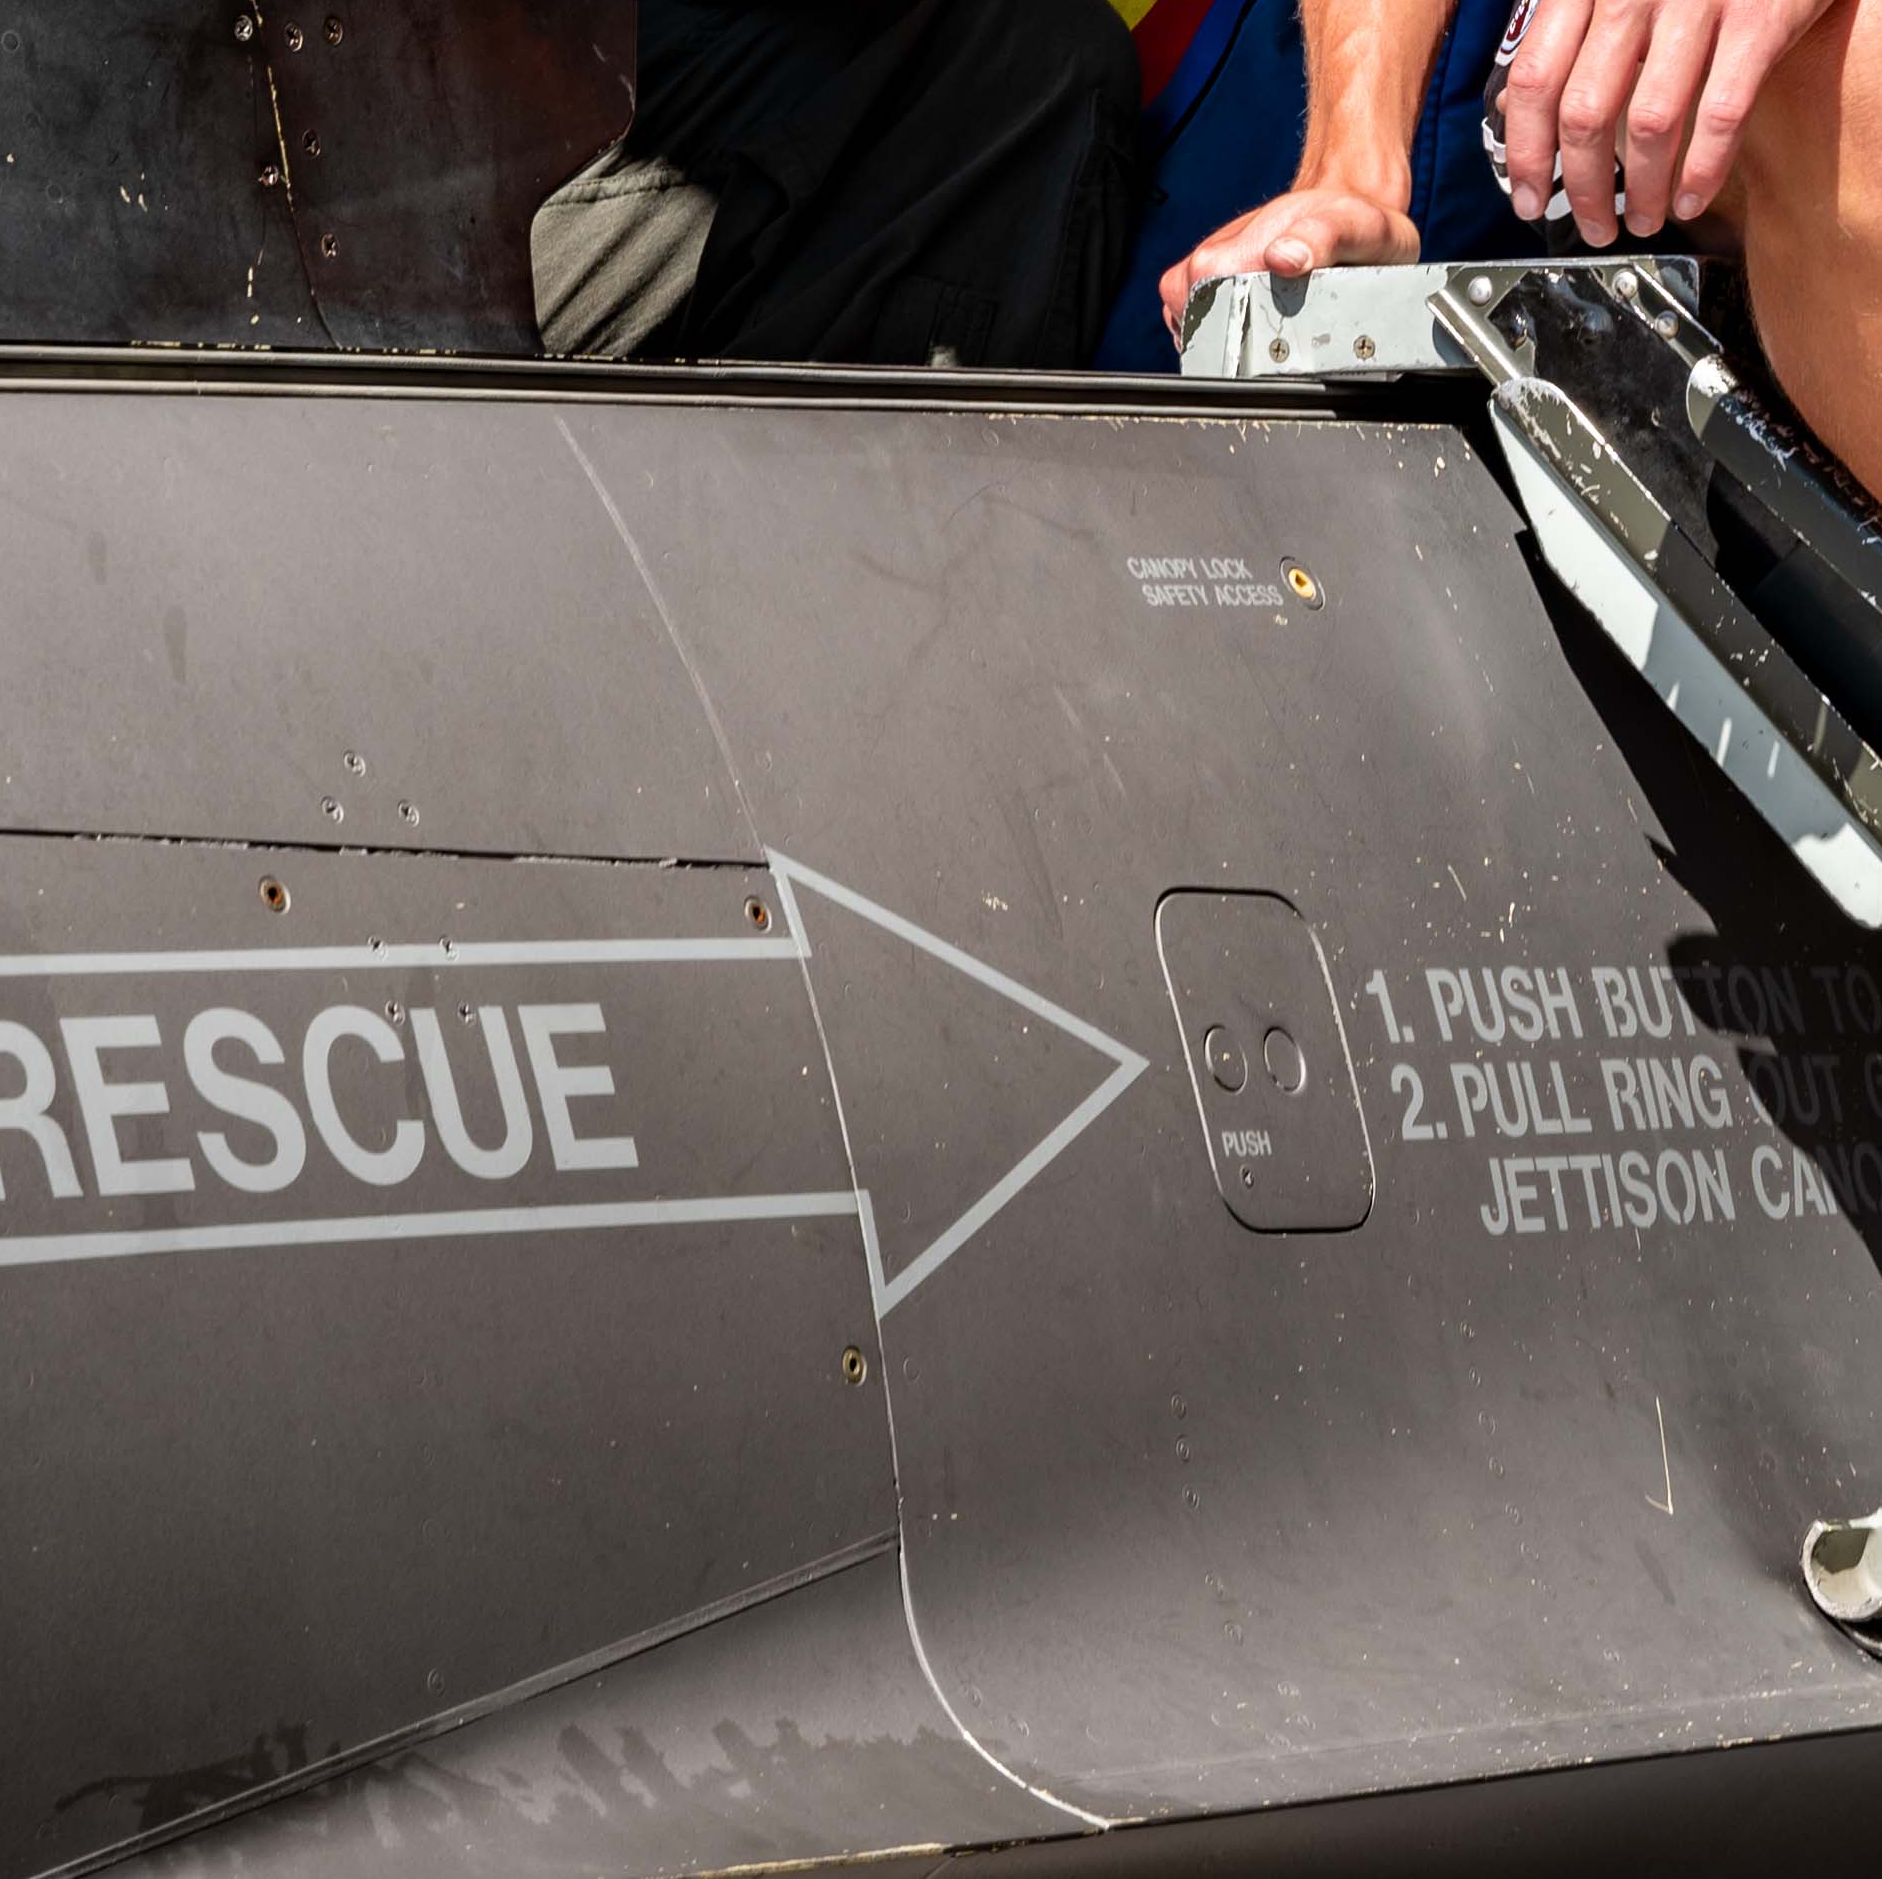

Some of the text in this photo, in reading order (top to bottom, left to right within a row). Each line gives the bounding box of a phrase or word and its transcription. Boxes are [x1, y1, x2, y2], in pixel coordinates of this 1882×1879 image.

[1127, 557, 1253, 580] CANOPY LOCK
[1142, 583, 1284, 607] SAFETY ACCESS
[1365, 968, 1414, 1043] 1.
[1425, 967, 1583, 1042] PUSH
[1591, 966, 1805, 1039] BUTTON
[1809, 963, 1882, 1034] TO
[1391, 1063, 1448, 1140] 2.
[1450, 1061, 1592, 1137] PULL
[1600, 1055, 1733, 1132] RING
[1750, 1051, 1843, 1125] OUT
[1221, 1130, 1273, 1158] PUSH
[1480, 1149, 1736, 1235] JETTISON
